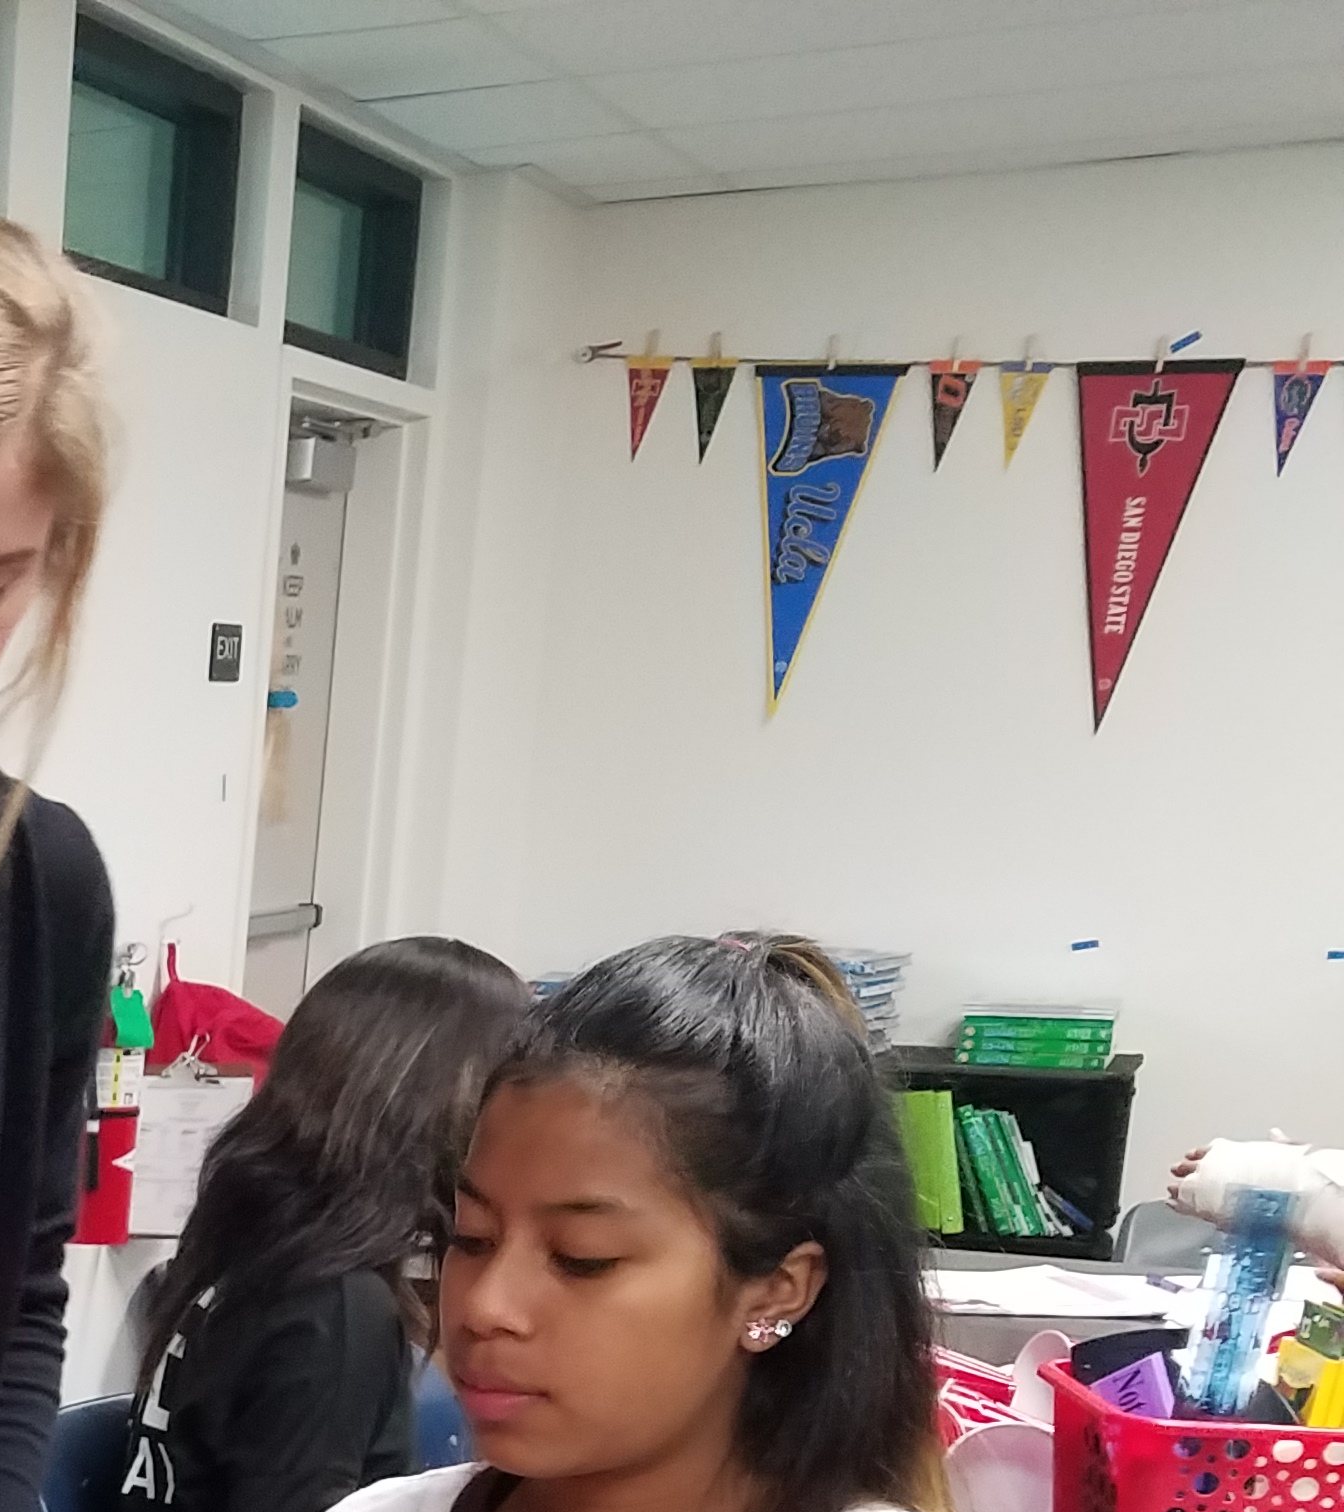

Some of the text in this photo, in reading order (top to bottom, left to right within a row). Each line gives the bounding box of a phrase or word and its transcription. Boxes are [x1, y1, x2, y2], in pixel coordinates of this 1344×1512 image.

[1104, 496, 1147, 635] SAN DIEGO STATE
[216, 635, 240, 661] EXIT
